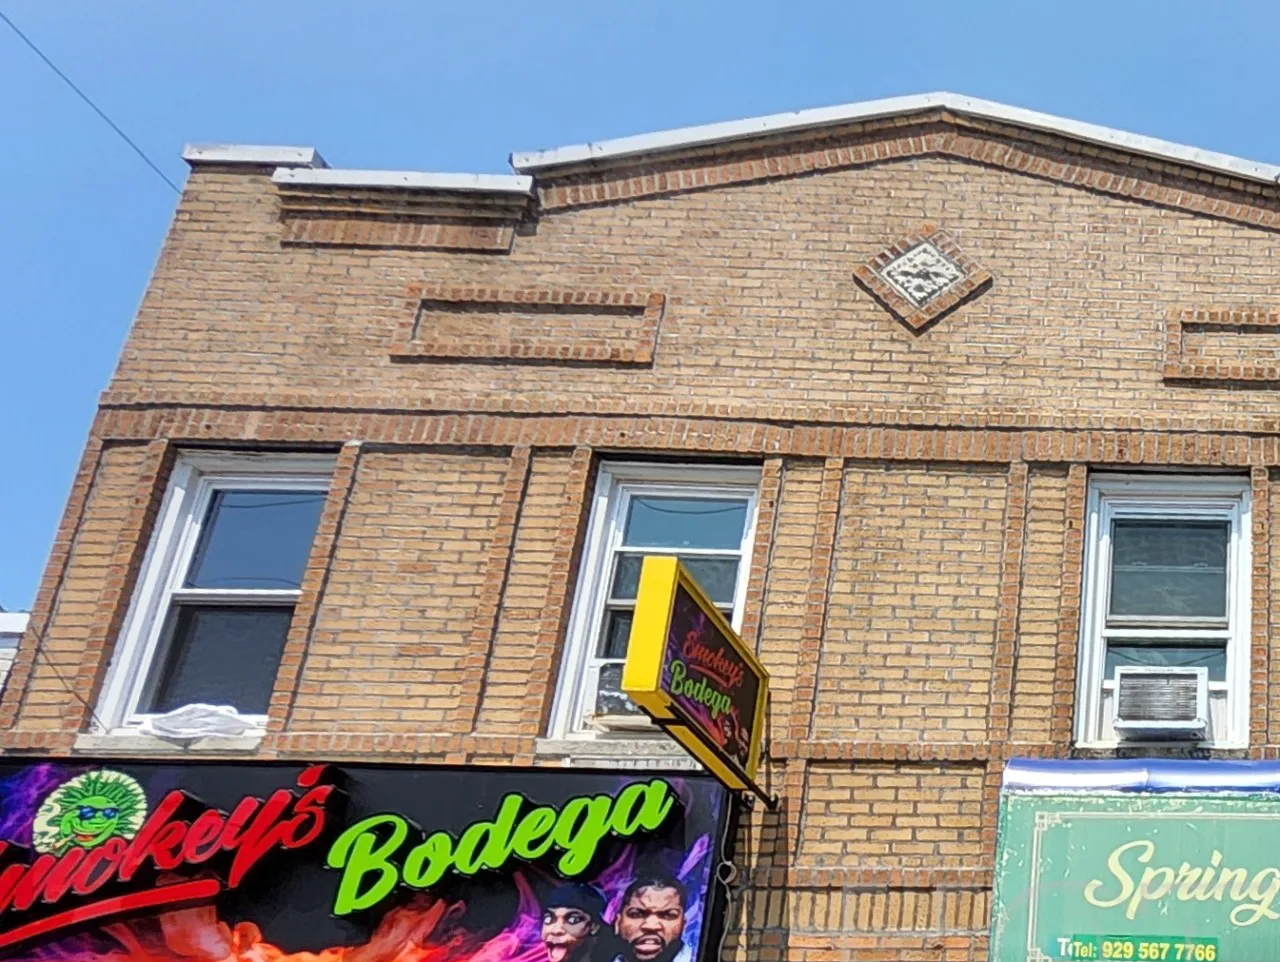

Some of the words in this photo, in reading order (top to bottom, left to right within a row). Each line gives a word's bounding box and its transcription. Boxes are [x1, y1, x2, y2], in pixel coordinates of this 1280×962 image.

[669, 659, 731, 718] Bodega
[0, 764, 334, 912] mokey's
[327, 779, 675, 916] Bodega
[1073, 941, 1098, 959] Tel:
[1102, 941, 1133, 960] 929
[1138, 942, 1170, 961] 567
[1174, 943, 1217, 962] 7766
